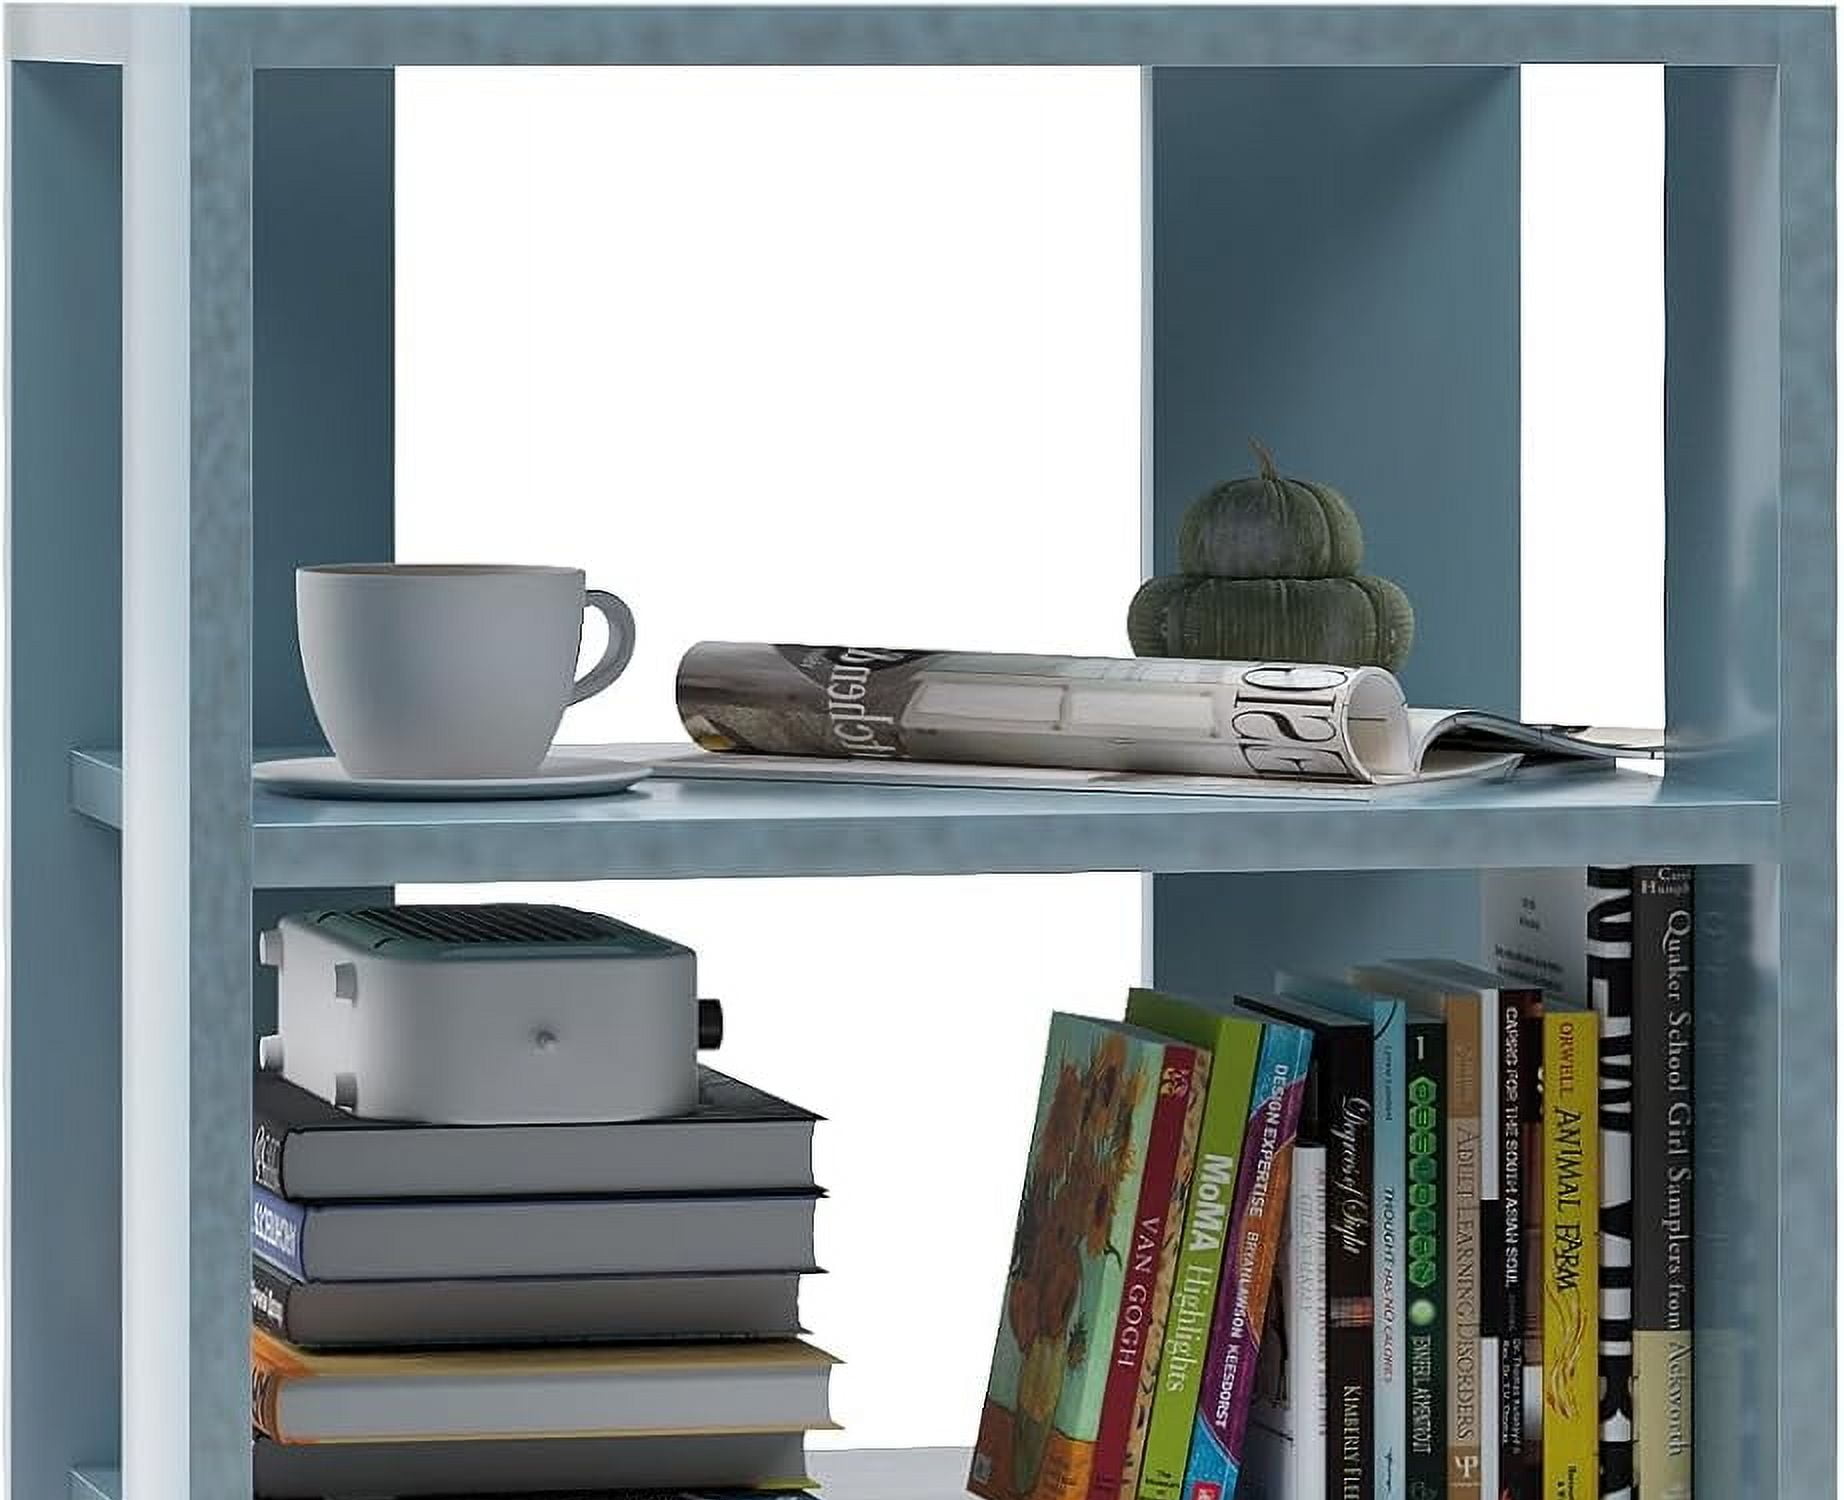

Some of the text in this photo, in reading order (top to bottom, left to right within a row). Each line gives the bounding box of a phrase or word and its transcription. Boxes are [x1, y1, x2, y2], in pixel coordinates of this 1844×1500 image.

[1663, 909, 1692, 1000] Quaker
[1505, 1069, 1518, 1101] FOR
[1559, 1022, 1574, 1098] ORWELL
[1668, 1010, 1692, 1091] School
[1250, 1064, 1289, 1217] DESIGN EXPERTISE
[1331, 1096, 1371, 1174] Degrees
[1505, 1106, 1518, 1137] THE
[1667, 1102, 1692, 1154] Girl
[1505, 1139, 1518, 1193] SOUTH
[1554, 1106, 1584, 1293] ANIMAL FARM
[1331, 1199, 1369, 1254] Sight
[1383, 1187, 1395, 1265] THOUGHT
[1505, 1197, 1518, 1243] ASIAN
[1661, 1167, 1692, 1273] Samplers
[1117, 1216, 1161, 1367] VAN GOGH
[1166, 1154, 1233, 1393] MoMA Highlights
[1456, 1127, 1481, 1440] ADULT LEARNING DISORDERS
[1505, 1247, 1518, 1286] SOUL
[1667, 1284, 1686, 1329] from
[1343, 1385, 1361, 1461] KIMBERLY
[1666, 1342, 1691, 1457] Ackworth
